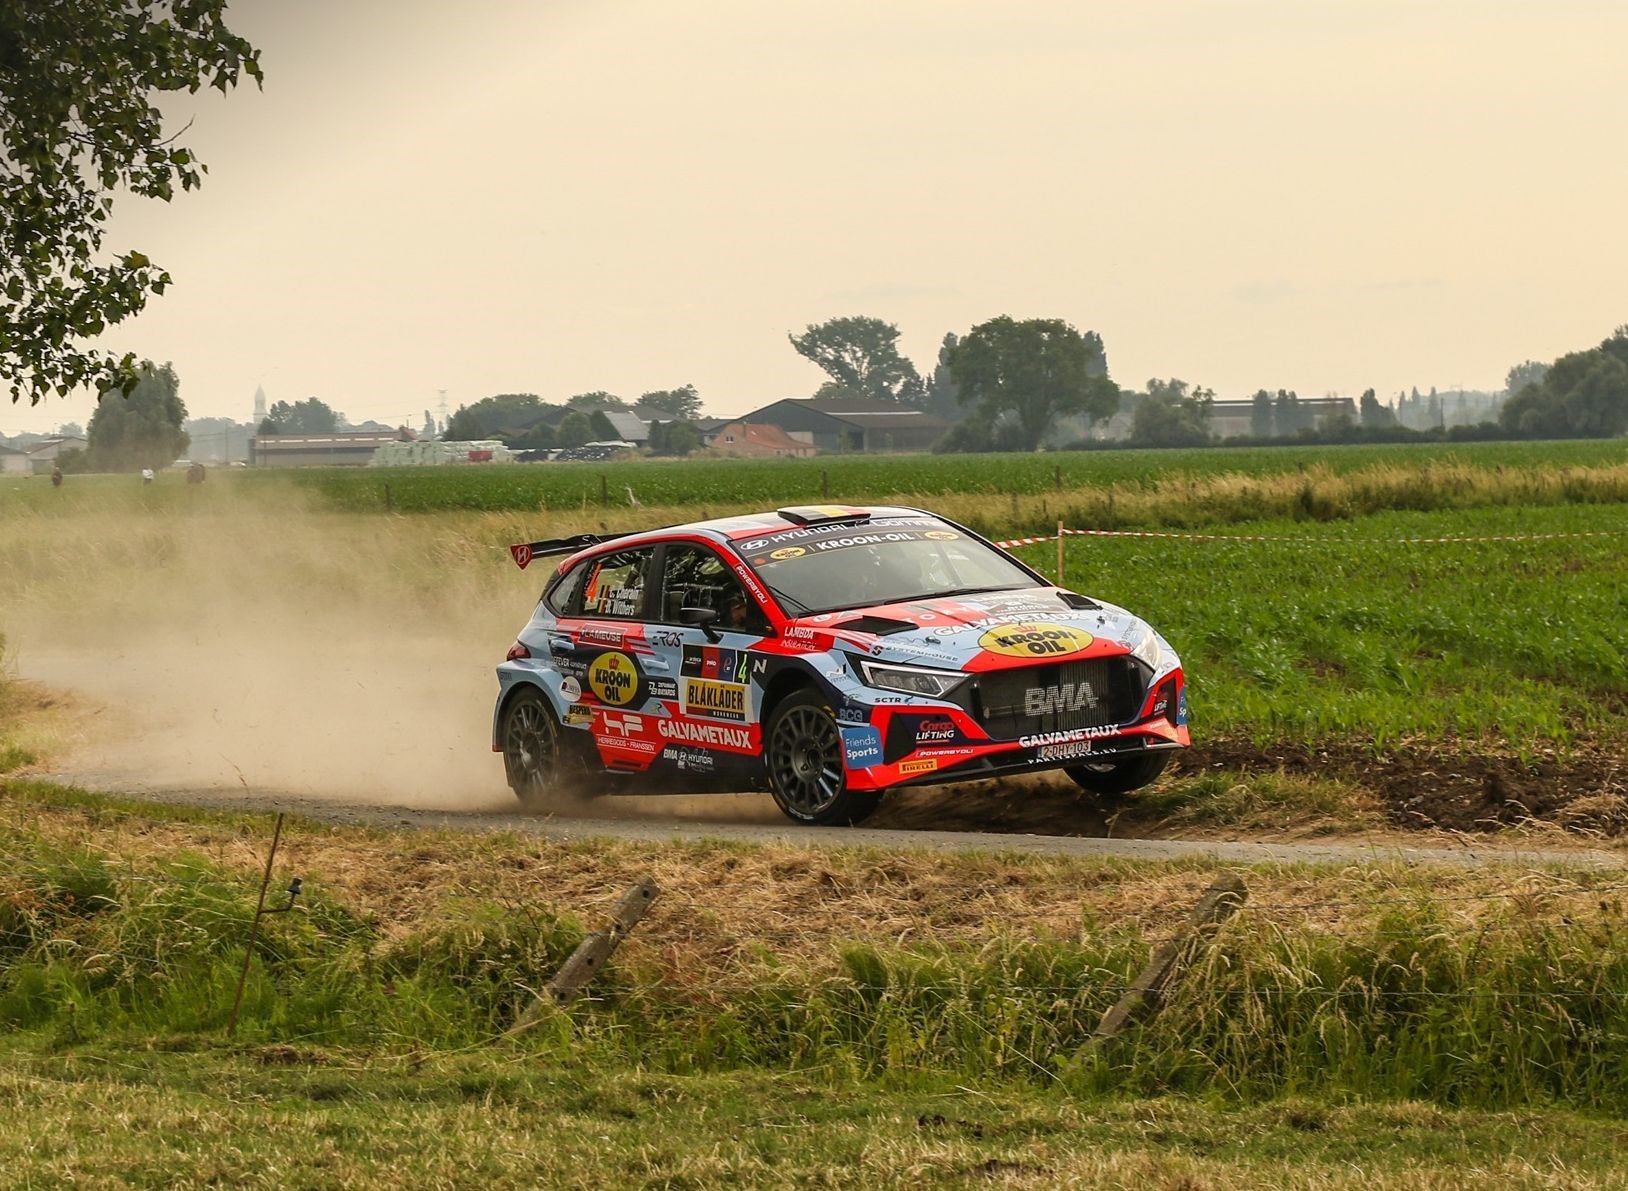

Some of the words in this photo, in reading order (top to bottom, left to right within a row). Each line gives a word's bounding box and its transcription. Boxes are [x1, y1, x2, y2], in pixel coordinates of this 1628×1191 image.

[771, 524, 849, 543] HYUNDAI
[816, 533, 915, 550] KROON-OIL
[784, 626, 814, 640] LAMBDA
[995, 629, 1077, 648] KROON
[1027, 640, 1067, 655] OIL
[738, 653, 748, 683] 4
[595, 668, 631, 688] KROON
[604, 685, 621, 702] OIL
[688, 681, 744, 711] BLÅKLÄDER
[1025, 682, 1099, 717] BMA
[657, 719, 753, 750] GALVAMETAUX
[919, 720, 955, 732] Cargo
[845, 734, 877, 748] Friends
[915, 730, 955, 741] LIFTING
[1018, 723, 1122, 749] GALVAMETAUX
[663, 748, 678, 760] BMA
[847, 748, 879, 760] Sports
[902, 760, 934, 772] PIRELLI
